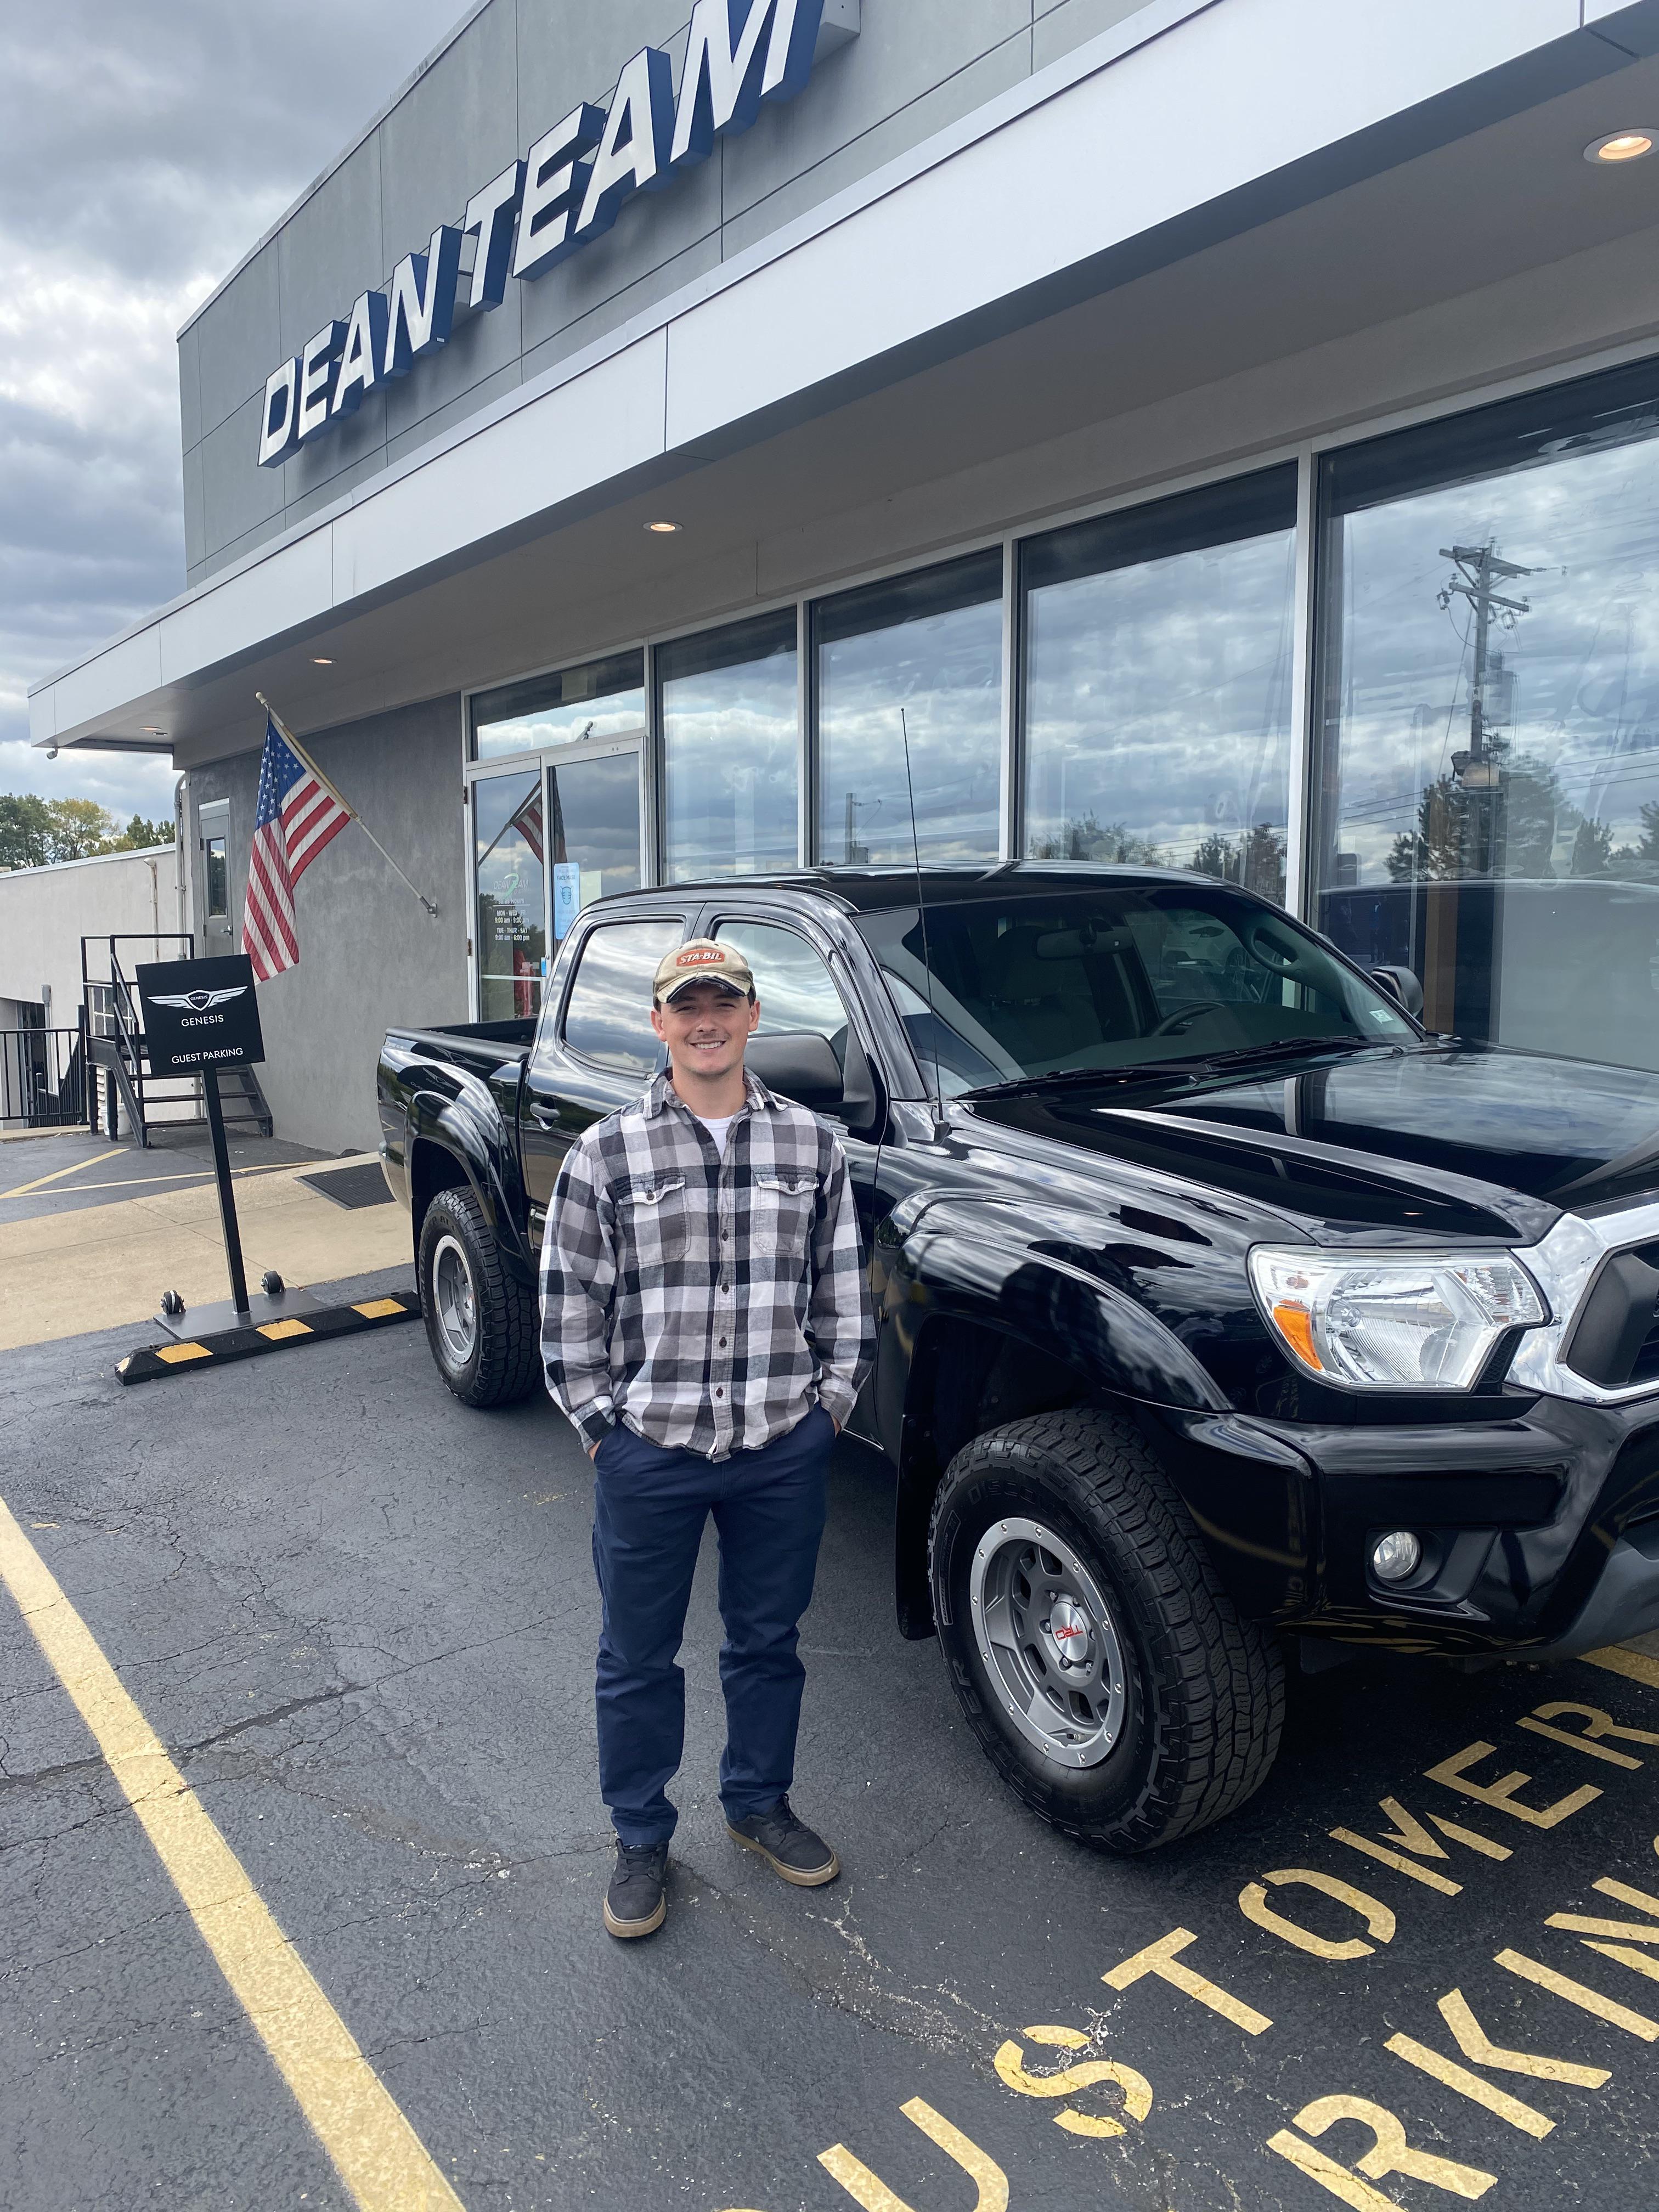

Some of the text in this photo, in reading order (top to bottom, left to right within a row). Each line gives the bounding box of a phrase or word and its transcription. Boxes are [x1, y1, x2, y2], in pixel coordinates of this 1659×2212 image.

[257, 0, 817, 468] DEAN TEAM
[679, 951, 722, 965] STA-BIL
[181, 1014, 224, 1026] GENESIS
[171, 1047, 244, 1064] GUEST PARKING
[1055, 1623, 1084, 1640] TRD
[711, 1701, 1659, 2212] USTOMER
[1266, 1835, 1659, 2212] RKIN
